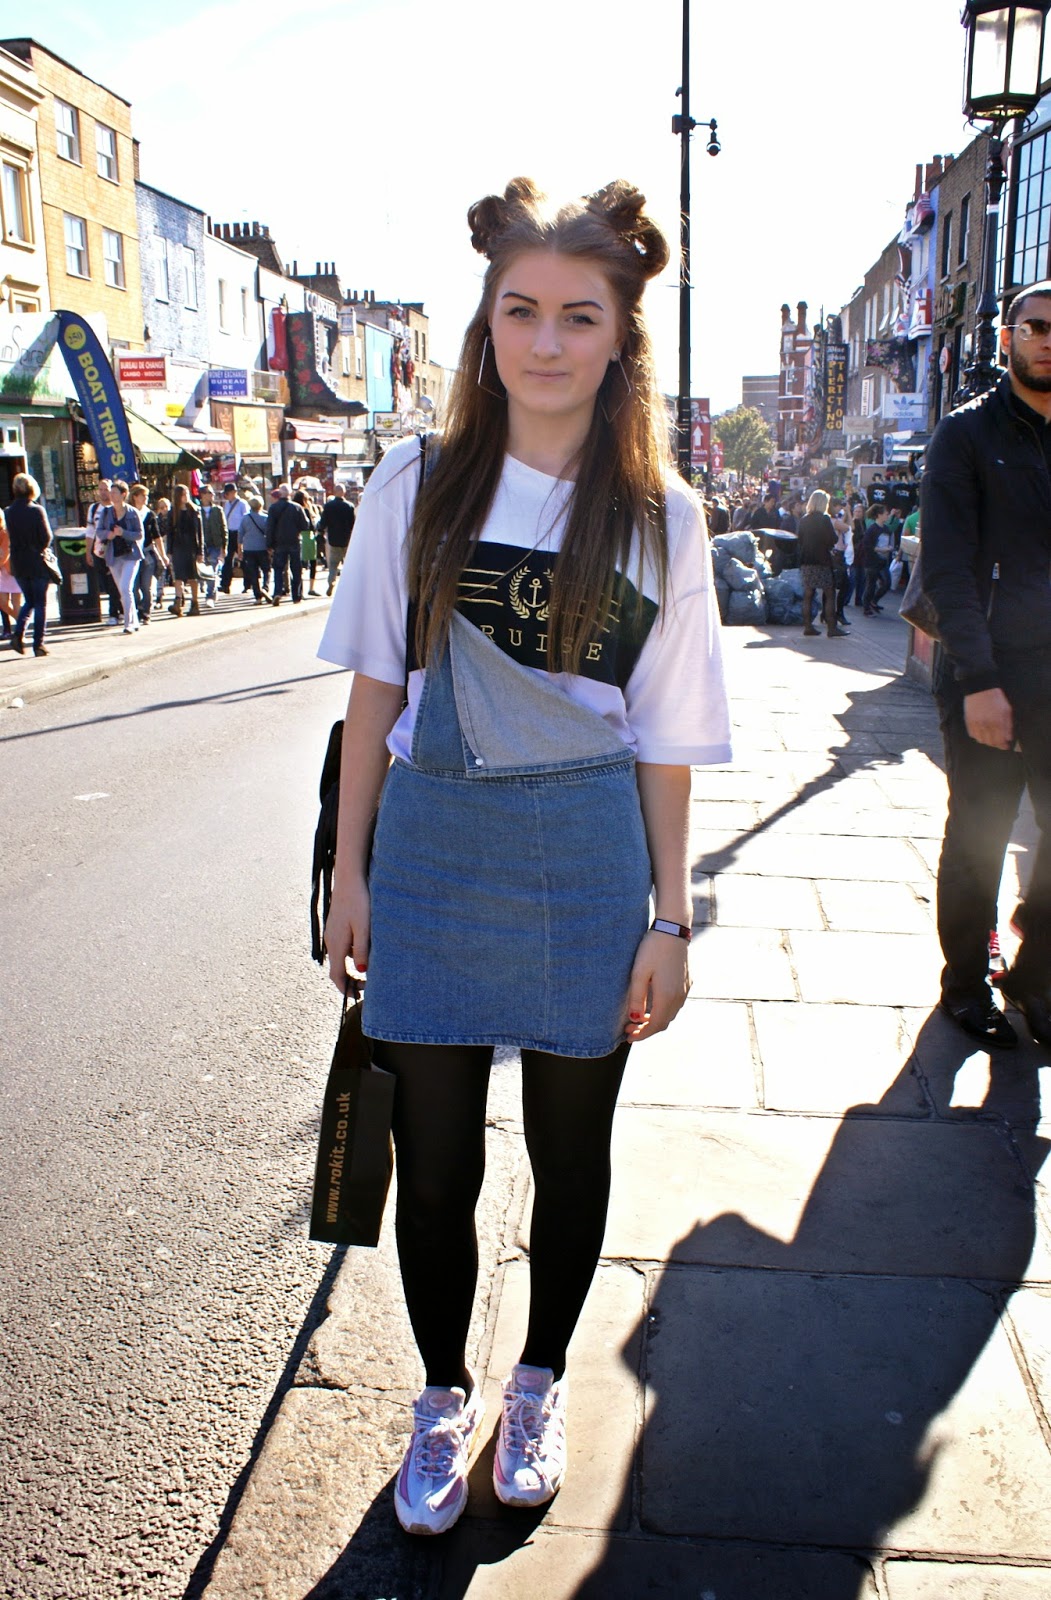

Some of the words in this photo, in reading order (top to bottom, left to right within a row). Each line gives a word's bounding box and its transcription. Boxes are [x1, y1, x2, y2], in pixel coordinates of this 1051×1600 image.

[120, 361, 138, 369] BUREAU
[138, 361, 145, 369] DE
[145, 361, 164, 369] CHANGE
[826, 360, 837, 430] PIERCING
[835, 361, 845, 429] TATTOO
[78, 352, 108, 404] BOAT
[98, 406, 126, 467] TRIPS
[480, 624, 603, 662] RUISE
[325, 1091, 351, 1224] www.rokit.co.uk
